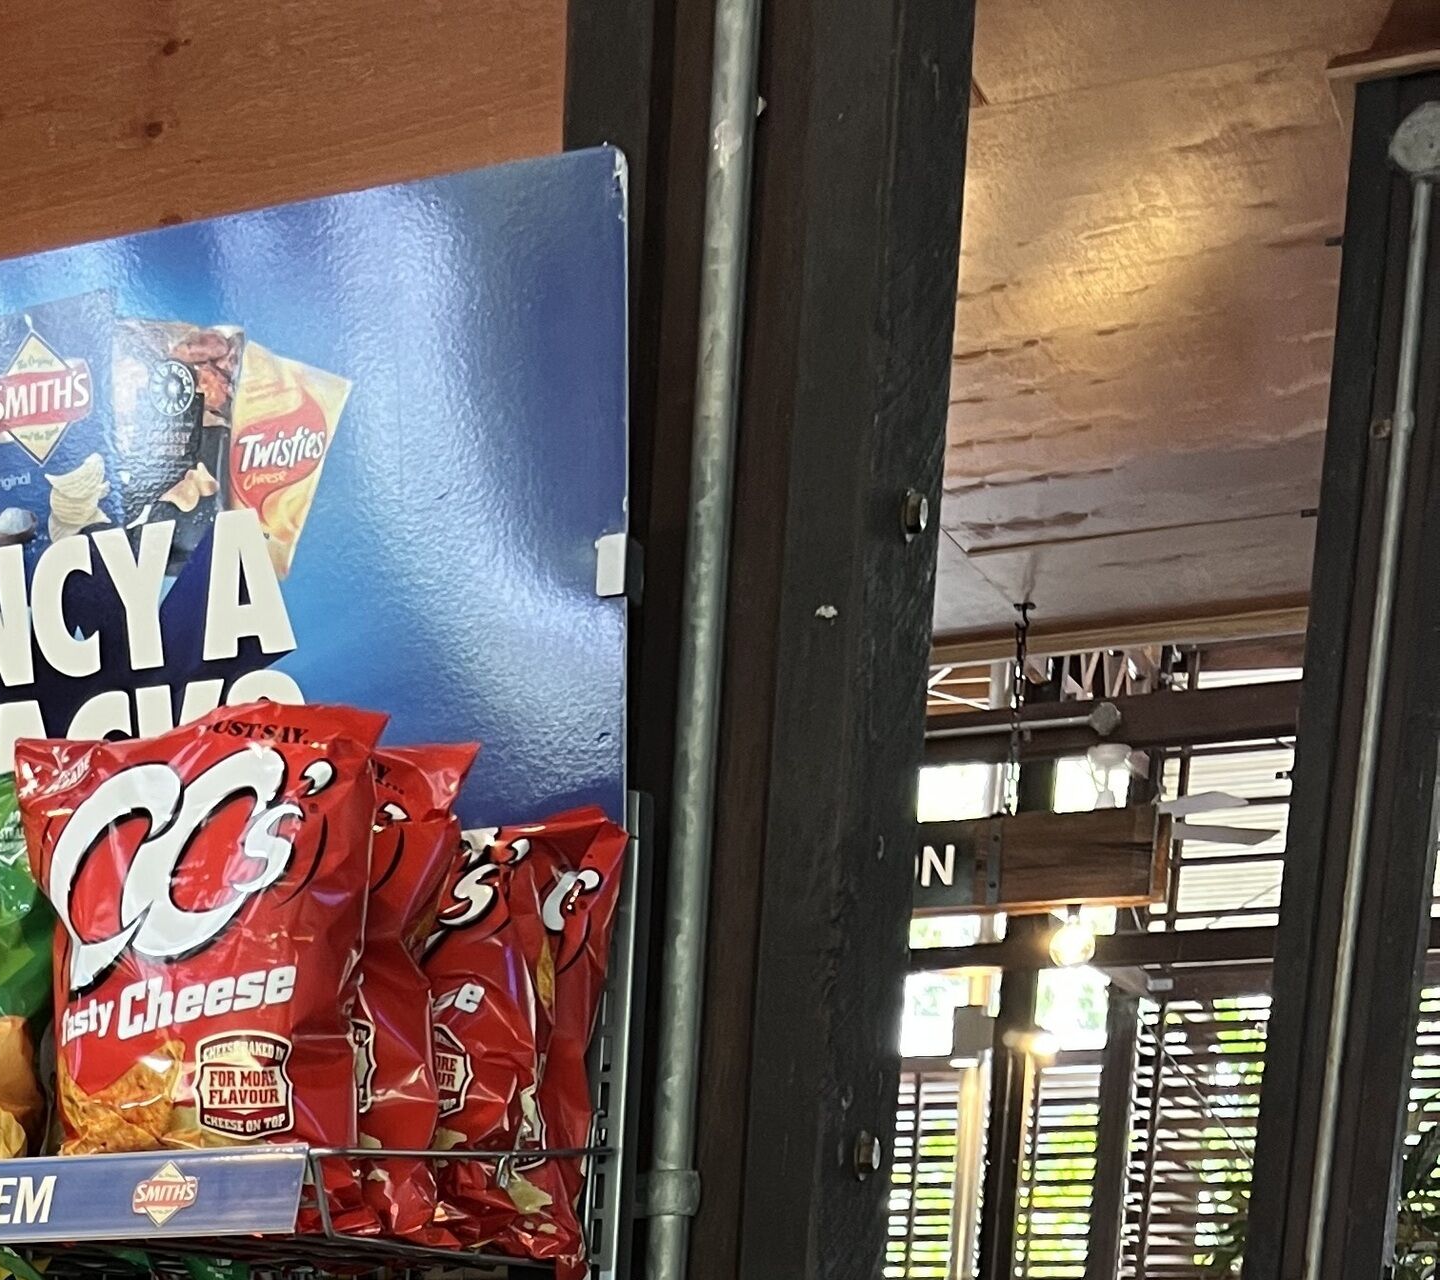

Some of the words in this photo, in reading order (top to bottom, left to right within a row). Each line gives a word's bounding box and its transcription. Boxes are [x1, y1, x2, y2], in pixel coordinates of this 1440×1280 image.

[238, 424, 326, 471] Twisties
[243, 471, 287, 492] Cheese
[200, 508, 297, 661] A
[117, 965, 297, 1041] Cheese
[209, 1070, 237, 1088] FOR
[239, 1069, 277, 1087] MORE
[209, 1088, 280, 1105] FLAVOUR
[203, 1114, 244, 1133] CHEESE
[263, 1113, 286, 1130] TOP
[134, 1180, 197, 1203] SMITH'S
